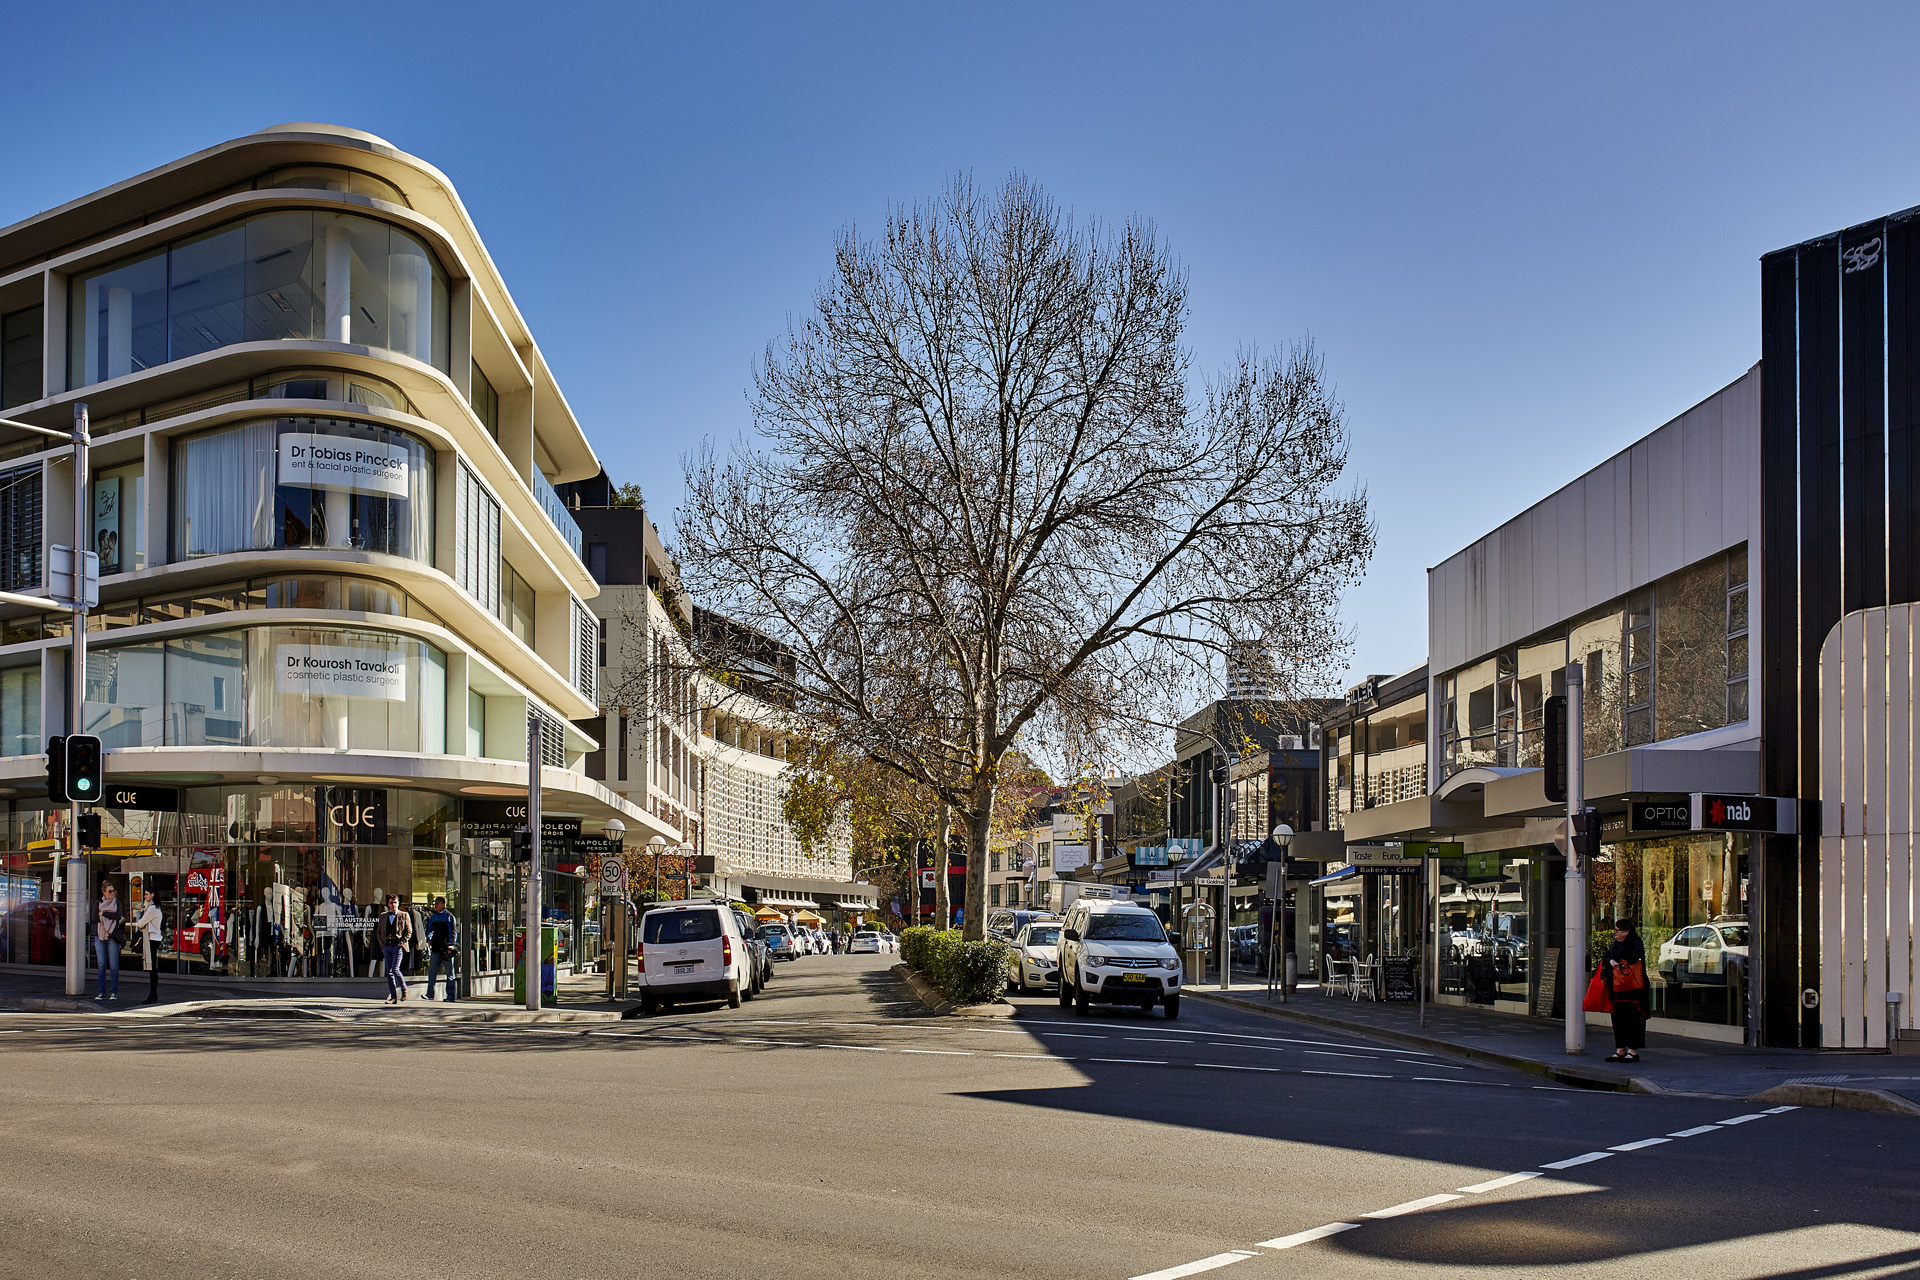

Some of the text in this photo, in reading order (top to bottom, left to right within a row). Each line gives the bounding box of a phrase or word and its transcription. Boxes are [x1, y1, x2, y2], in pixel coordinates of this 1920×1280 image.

[291, 446, 402, 470] Dr Tobias Pincock
[317, 462, 341, 471] facial
[344, 465, 371, 475] plastic
[373, 468, 402, 480] surgeon
[288, 656, 399, 674] Dr Kourosh Tavakoli
[287, 671, 399, 686] cosmetic plastic surgeon
[116, 791, 136, 804] CUE
[330, 805, 375, 827] CUE
[506, 806, 526, 817] CUE
[1727, 801, 1750, 820] nab
[1353, 851, 1372, 860] Taste
[605, 866, 619, 878] 50
